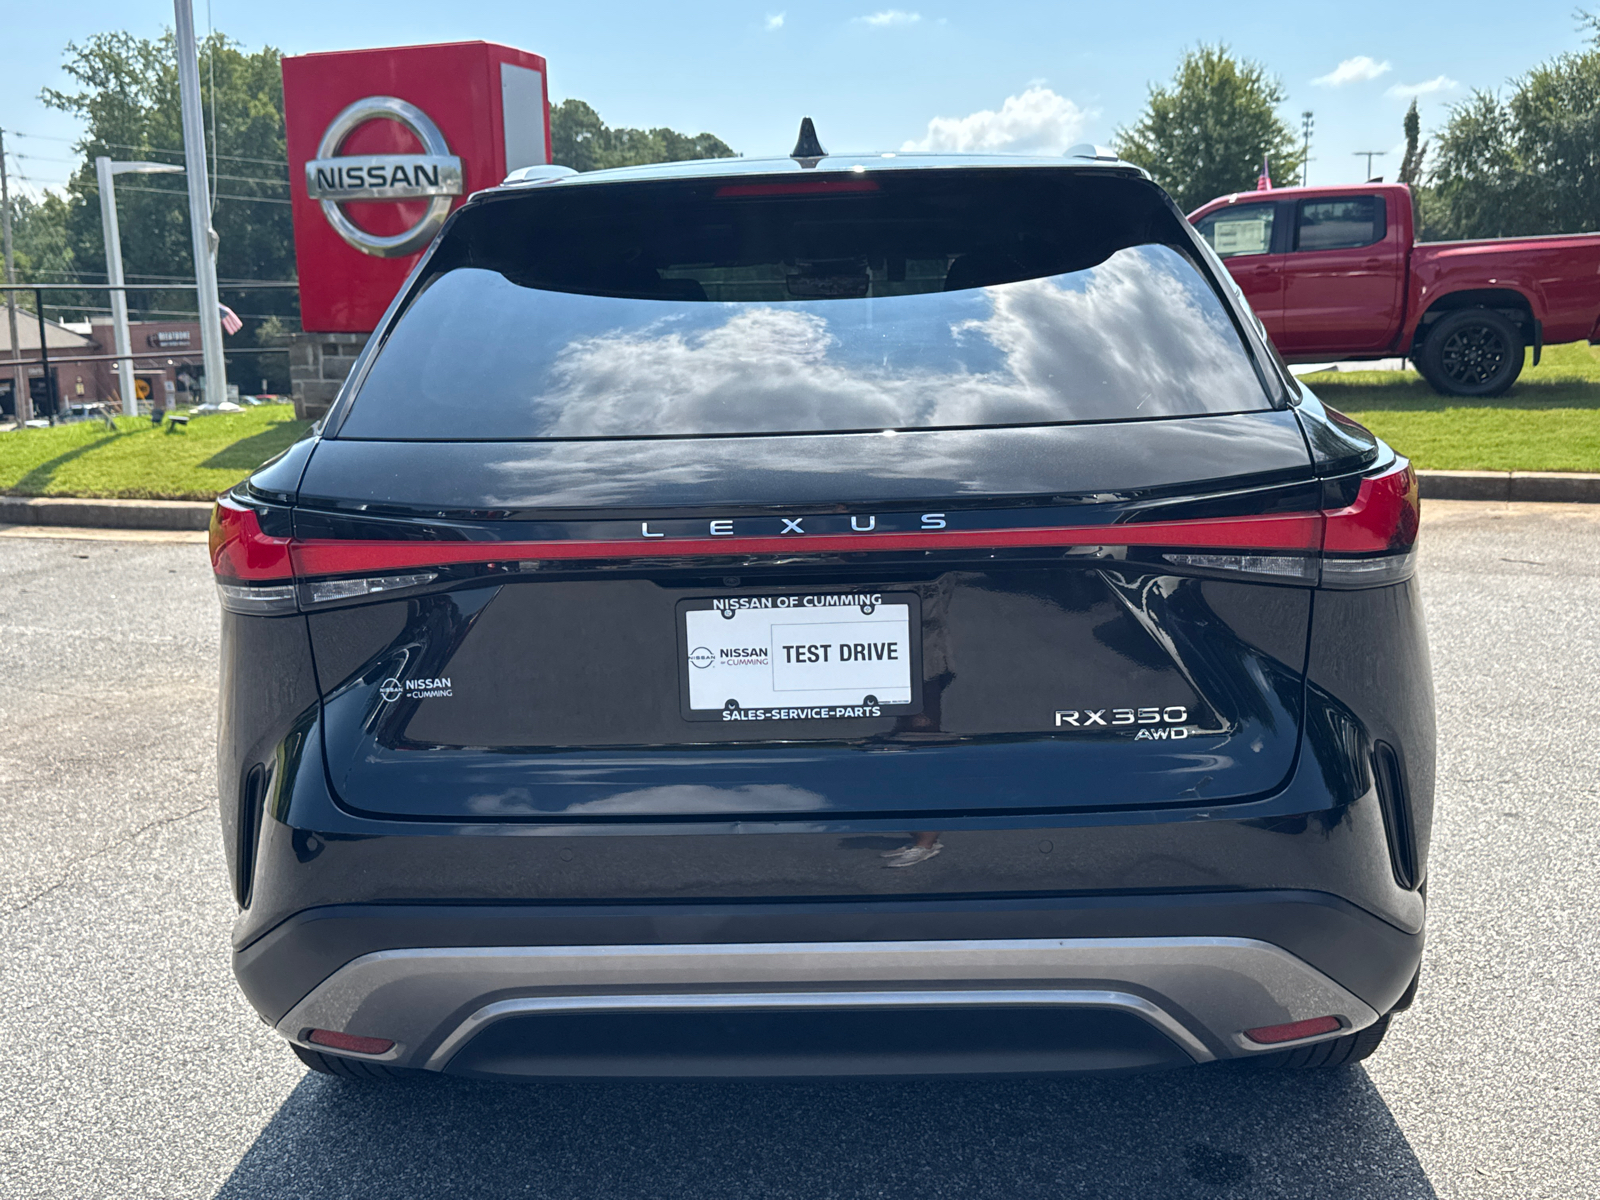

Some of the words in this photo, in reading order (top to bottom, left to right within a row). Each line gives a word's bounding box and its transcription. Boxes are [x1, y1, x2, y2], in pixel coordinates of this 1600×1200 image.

[317, 165, 439, 189] NISSAN
[641, 513, 946, 537] LEXUS
[713, 598, 772, 610] NISSAN
[776, 597, 799, 607] OF
[803, 594, 882, 607] CUMMING
[720, 648, 768, 658] NISSAN
[783, 644, 832, 664] TEST
[839, 642, 899, 662] DRIVE
[727, 658, 768, 666] CUMMING
[406, 678, 451, 689] NISSAN
[412, 690, 452, 698] CUMMING
[722, 707, 881, 720] SALES-SERVICE-PARTS
[1134, 727, 1188, 741] AWD
